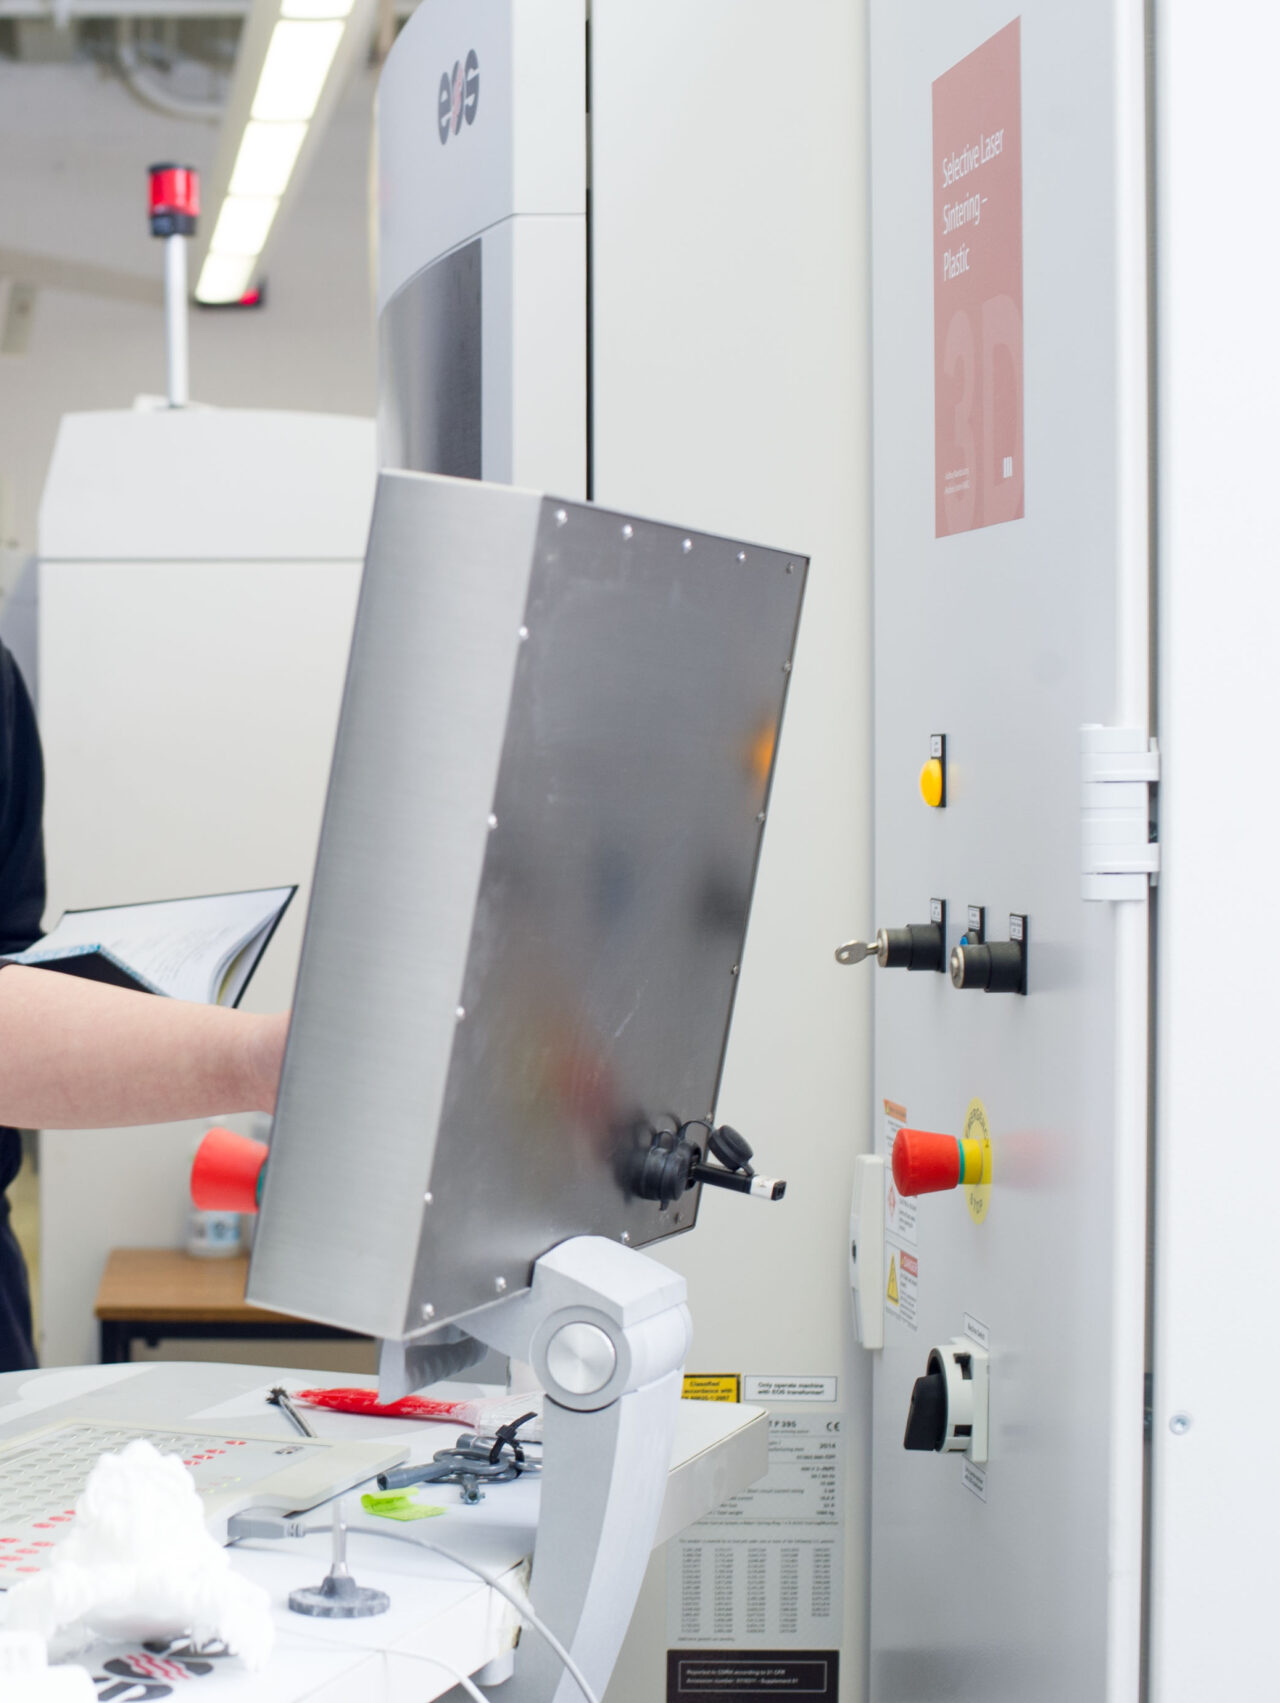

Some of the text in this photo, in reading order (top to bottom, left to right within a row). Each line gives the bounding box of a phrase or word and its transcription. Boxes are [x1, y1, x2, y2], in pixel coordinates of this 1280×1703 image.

[942, 128, 1005, 189] Selective Laser
[942, 192, 981, 235] Sintering
[943, 243, 971, 282] Plastic
